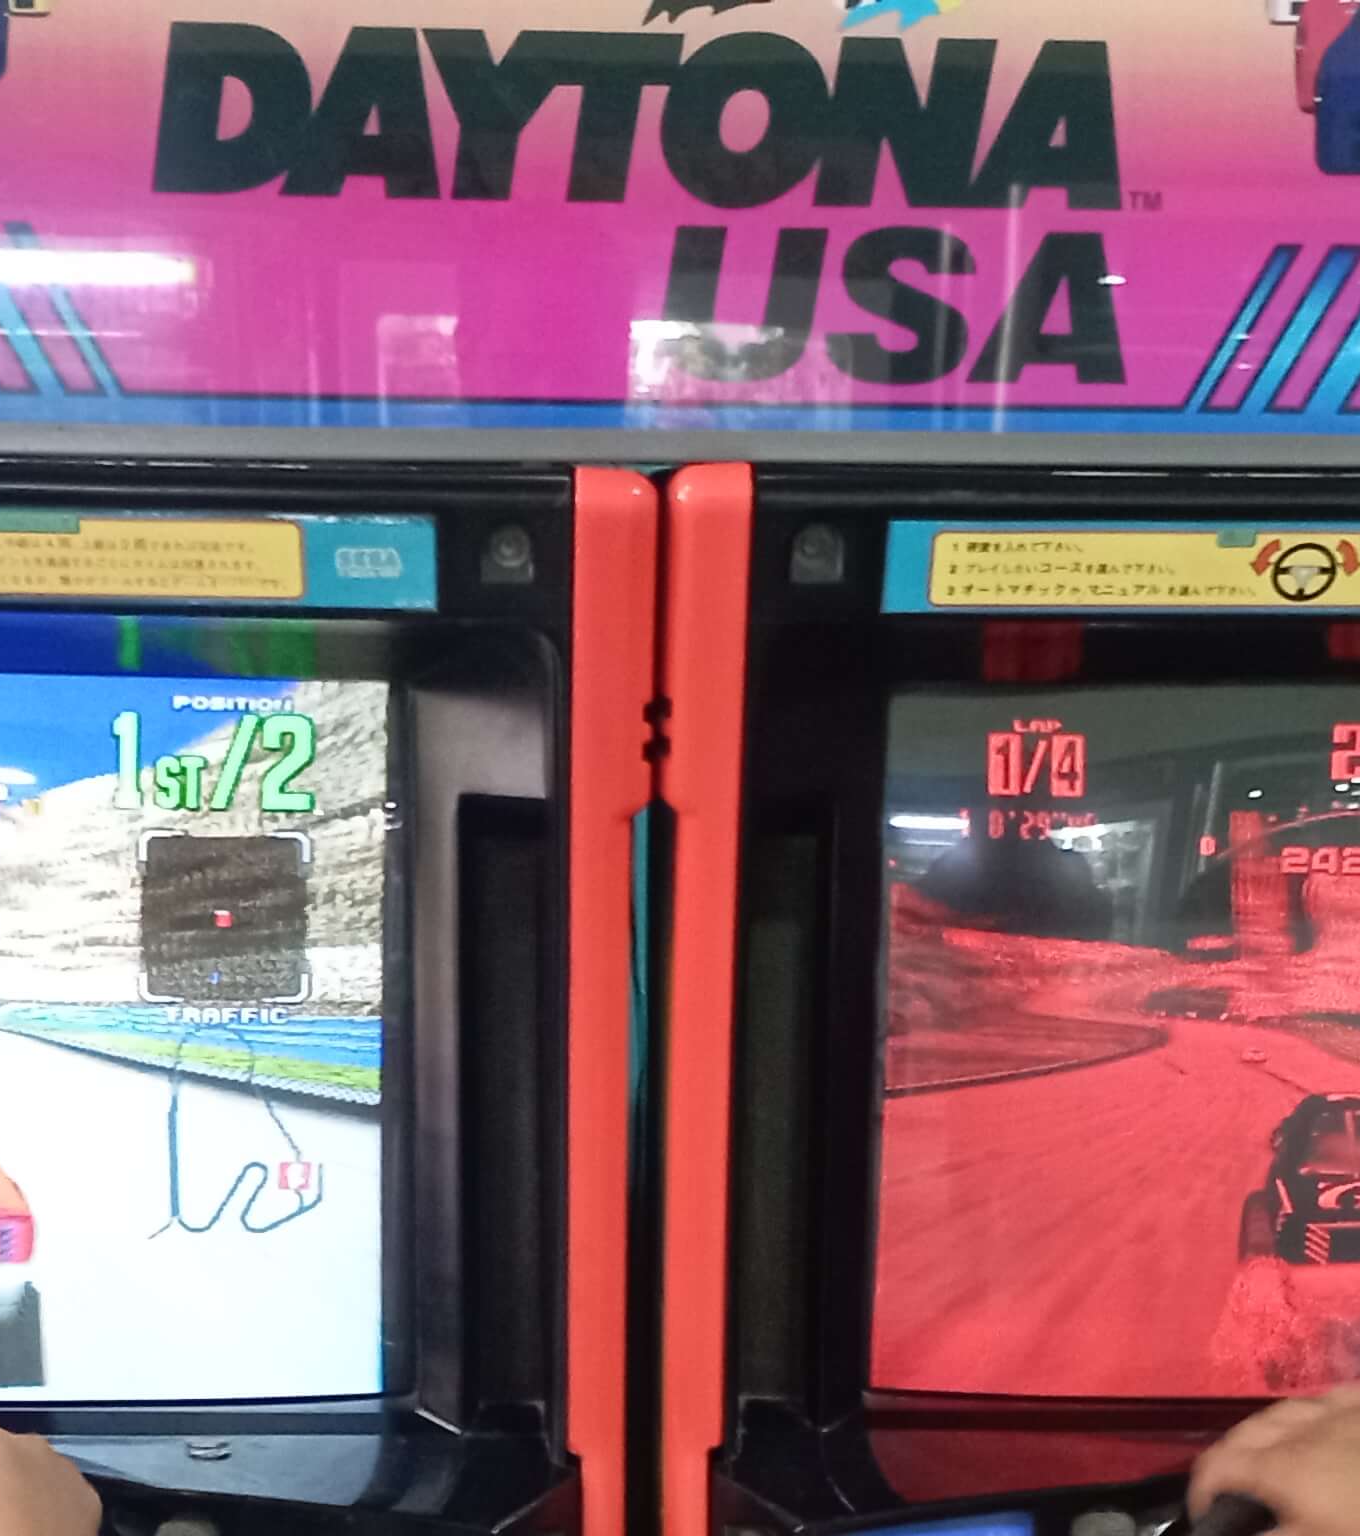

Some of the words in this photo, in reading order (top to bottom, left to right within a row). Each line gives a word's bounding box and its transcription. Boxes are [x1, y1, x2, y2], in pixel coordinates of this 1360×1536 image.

[152, 22, 1126, 210] DAYTONA
[662, 226, 1127, 385] USA
[173, 695, 291, 711] POSITION
[987, 733, 1086, 797] 1/4
[166, 1007, 290, 1025] TRAFFIC
